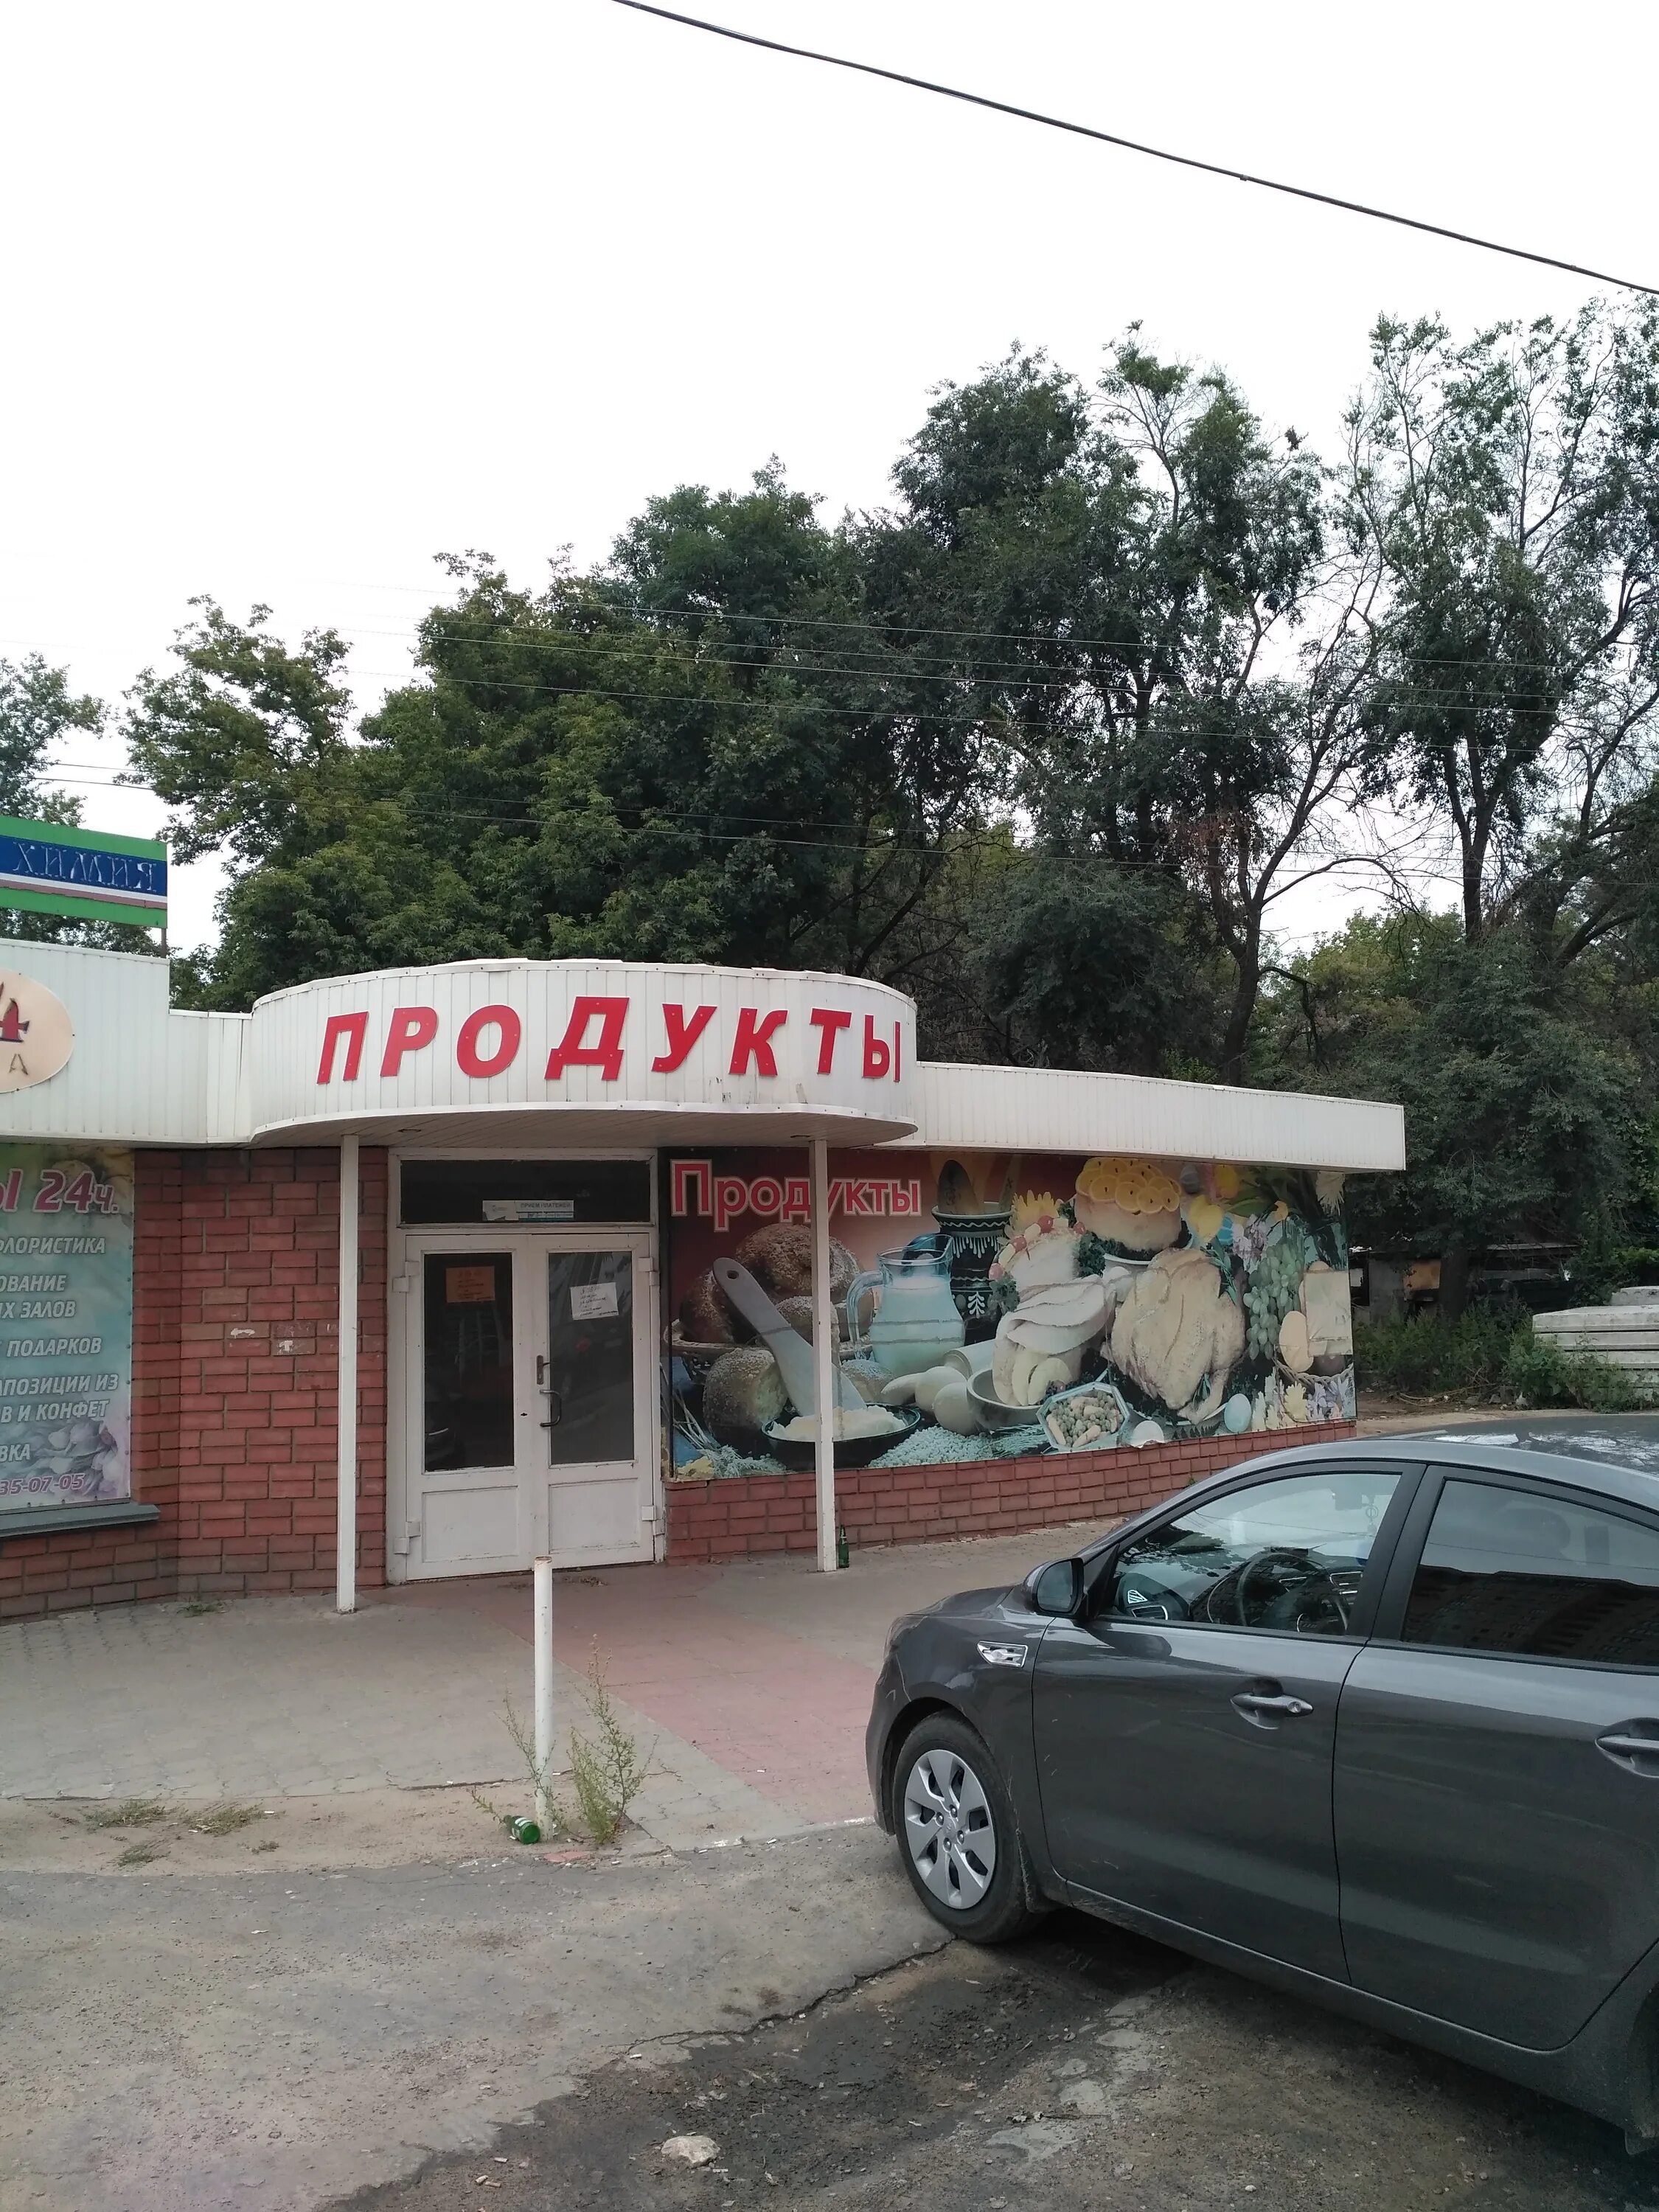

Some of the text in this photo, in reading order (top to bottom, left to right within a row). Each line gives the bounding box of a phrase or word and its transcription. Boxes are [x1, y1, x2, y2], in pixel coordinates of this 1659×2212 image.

[13, 841, 157, 892] ХИМИЯ
[316, 996, 901, 1084] ПРОДУКТЫ
[670, 1159, 922, 1232] Продукты
[0, 1237, 106, 1254] ЛОРИСТИКА
[0, 1301, 77, 1318] Х ЗАЛОВ
[7, 1338, 102, 1357] ПОДАРКОВ
[0, 1374, 119, 1397] ПОЗИЦИИ ИЗ
[17, 1405, 32, 1422] И
[35, 1399, 111, 1422] КОНФЕТ
